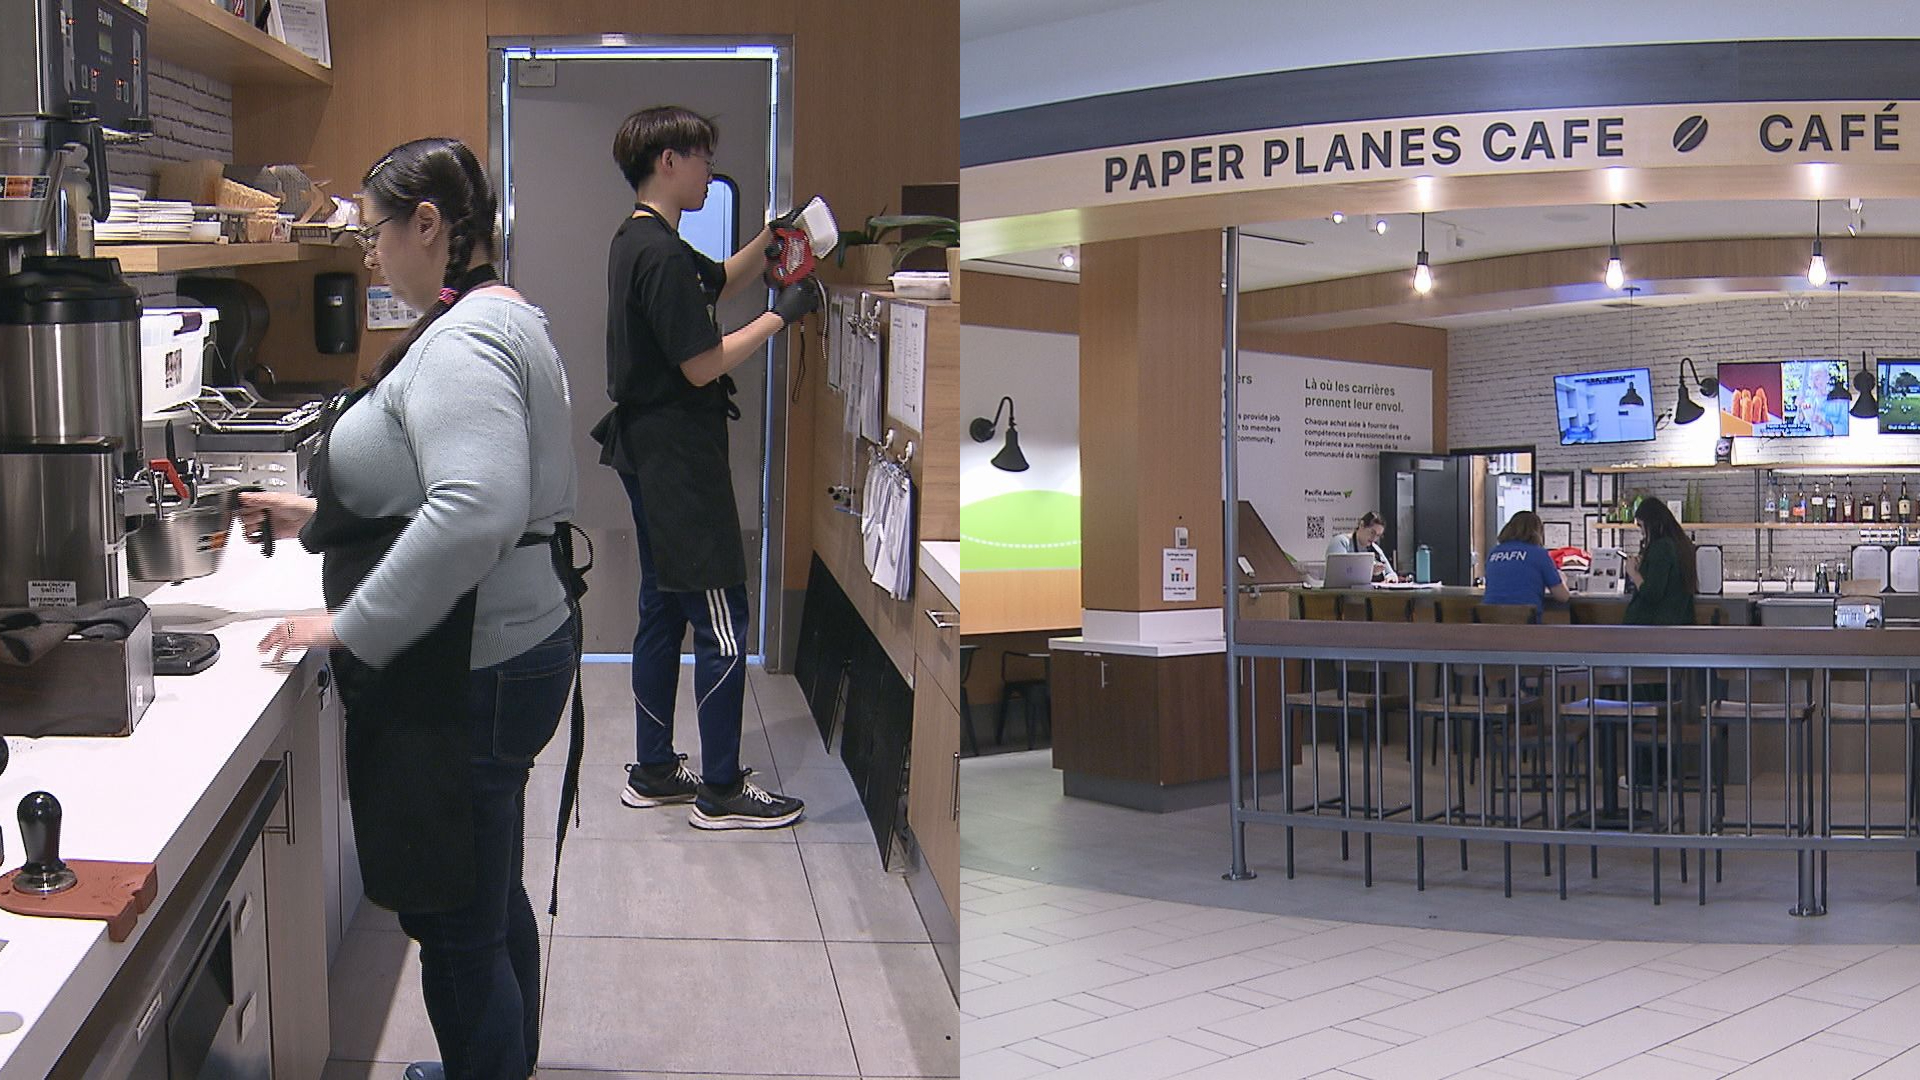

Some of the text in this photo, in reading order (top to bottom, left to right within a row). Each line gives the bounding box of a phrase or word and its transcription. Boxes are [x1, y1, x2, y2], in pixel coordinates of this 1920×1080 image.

[1759, 102, 1900, 153] CAFÉ
[1104, 117, 1625, 193] PAPER PLANES CAFE
[1304, 378, 1396, 397] Là où les carrières
[1304, 397, 1404, 413] prennent leur envol.
[1243, 413, 1268, 422] provide
[1269, 414, 1281, 423] job
[1304, 417, 1329, 427] Chaque
[1329, 420, 1347, 428] achat
[1348, 421, 1361, 429] aide
[1367, 422, 1388, 430] fournir
[1388, 423, 1399, 431] des
[1250, 424, 1281, 433] members
[1304, 428, 1346, 437] compétences
[1346, 431, 1395, 440] professionnelles
[1355, 442, 1383, 450] membres
[1304, 449, 1345, 459] communauté
[1345, 451, 1354, 459] de
[1489, 550, 1527, 562] #PAFN
